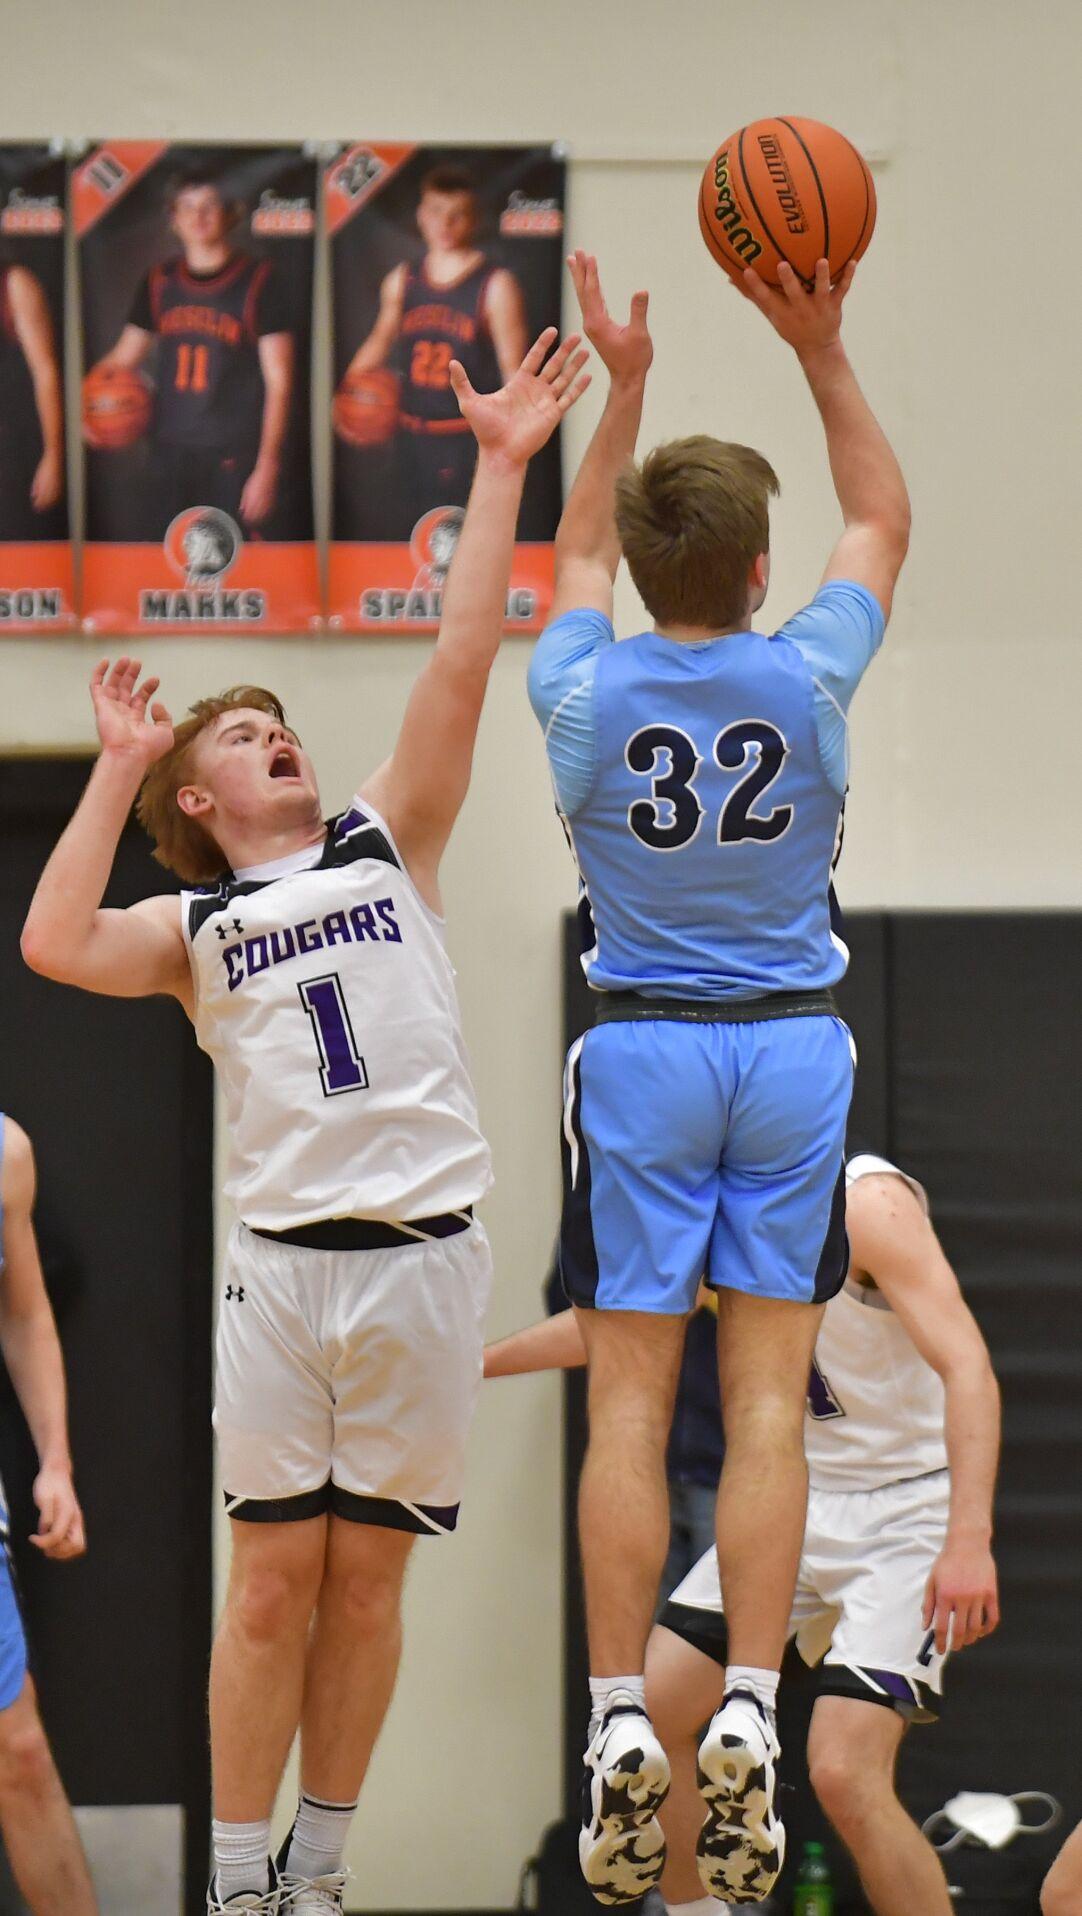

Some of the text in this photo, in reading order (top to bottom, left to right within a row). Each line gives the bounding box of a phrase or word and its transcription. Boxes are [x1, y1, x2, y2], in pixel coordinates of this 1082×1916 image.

[88, 151, 129, 194] 11
[331, 150, 383, 199] 22
[714, 150, 763, 265] Wilson
[757, 134, 805, 235] EVOLUTION
[175, 343, 209, 392] 11
[410, 339, 453, 389] 22
[139, 588, 265, 621] MARKS
[624, 718, 794, 853] 32
[222, 897, 403, 992] COUGARS
[297, 972, 370, 1098] 1
